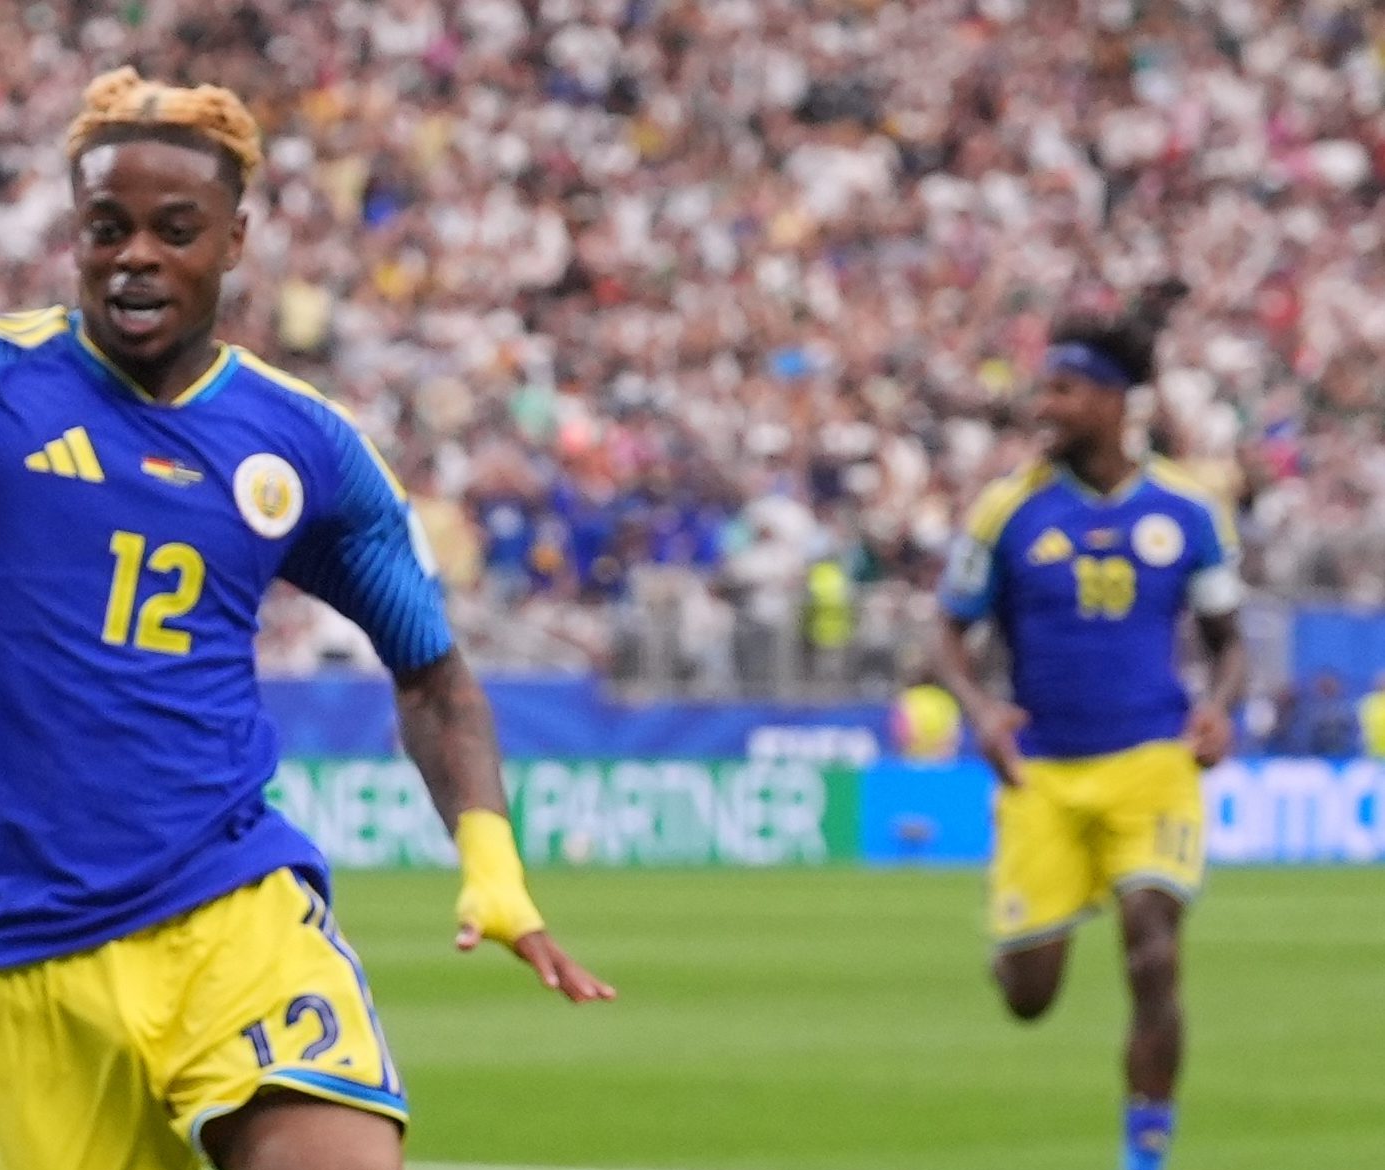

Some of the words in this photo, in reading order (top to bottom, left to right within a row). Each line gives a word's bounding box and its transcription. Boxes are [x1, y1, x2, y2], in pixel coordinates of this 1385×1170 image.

[103, 531, 206, 655] 12
[526, 761, 828, 866] PARTNER
[241, 994, 352, 1069] 12
